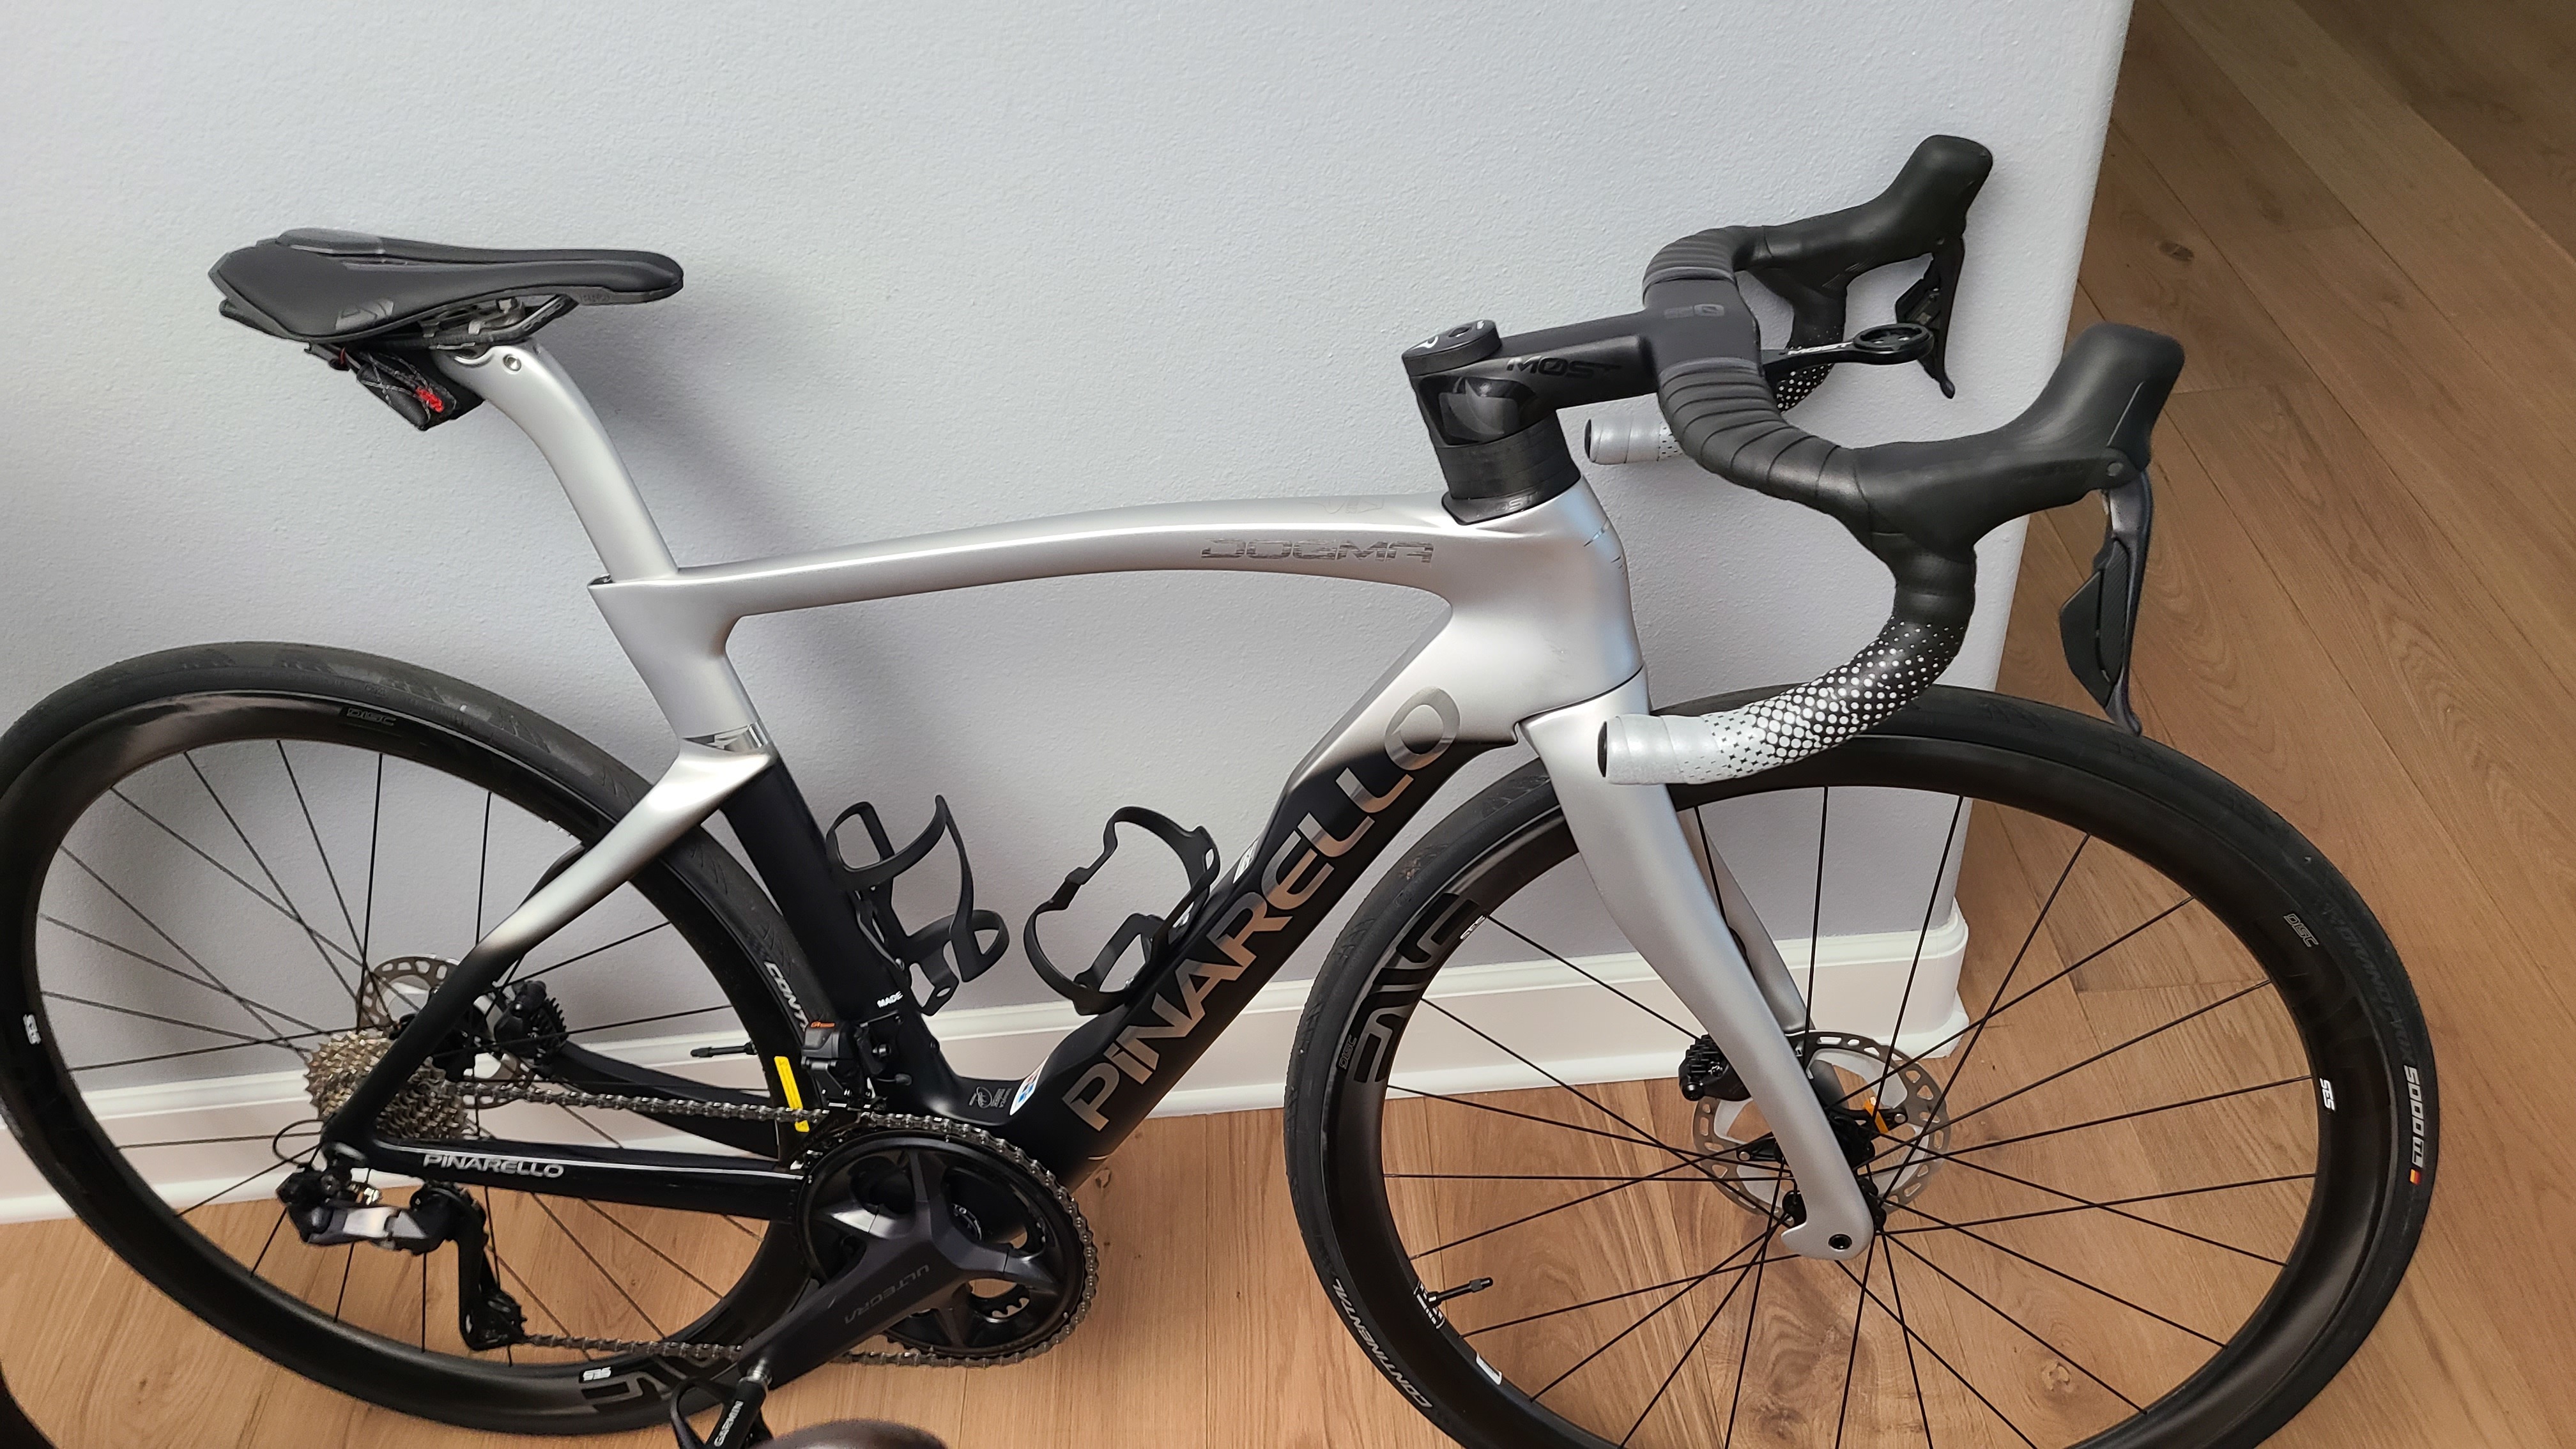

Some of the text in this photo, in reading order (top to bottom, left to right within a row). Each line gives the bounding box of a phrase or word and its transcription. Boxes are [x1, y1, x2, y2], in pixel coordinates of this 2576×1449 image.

[1506, 355, 1623, 379] MOST
[1201, 539, 1434, 564] DOGMA
[347, 707, 396, 726] DISC
[1061, 686, 1461, 1132] PINARELLO
[2283, 913, 2319, 947] DISC
[877, 990, 903, 1008] MADE
[1338, 1034, 1357, 1070] DISC
[2319, 1078, 2336, 1111] SES
[2404, 1064, 2425, 1137] 5000
[423, 1153, 564, 1179] PINARELLO
[2412, 1136, 2425, 1169] TL
[844, 1264, 930, 1324] ULTEGRA
[1332, 1278, 1433, 1408] CONTINENTAL
[714, 1400, 744, 1447] GARMIN
